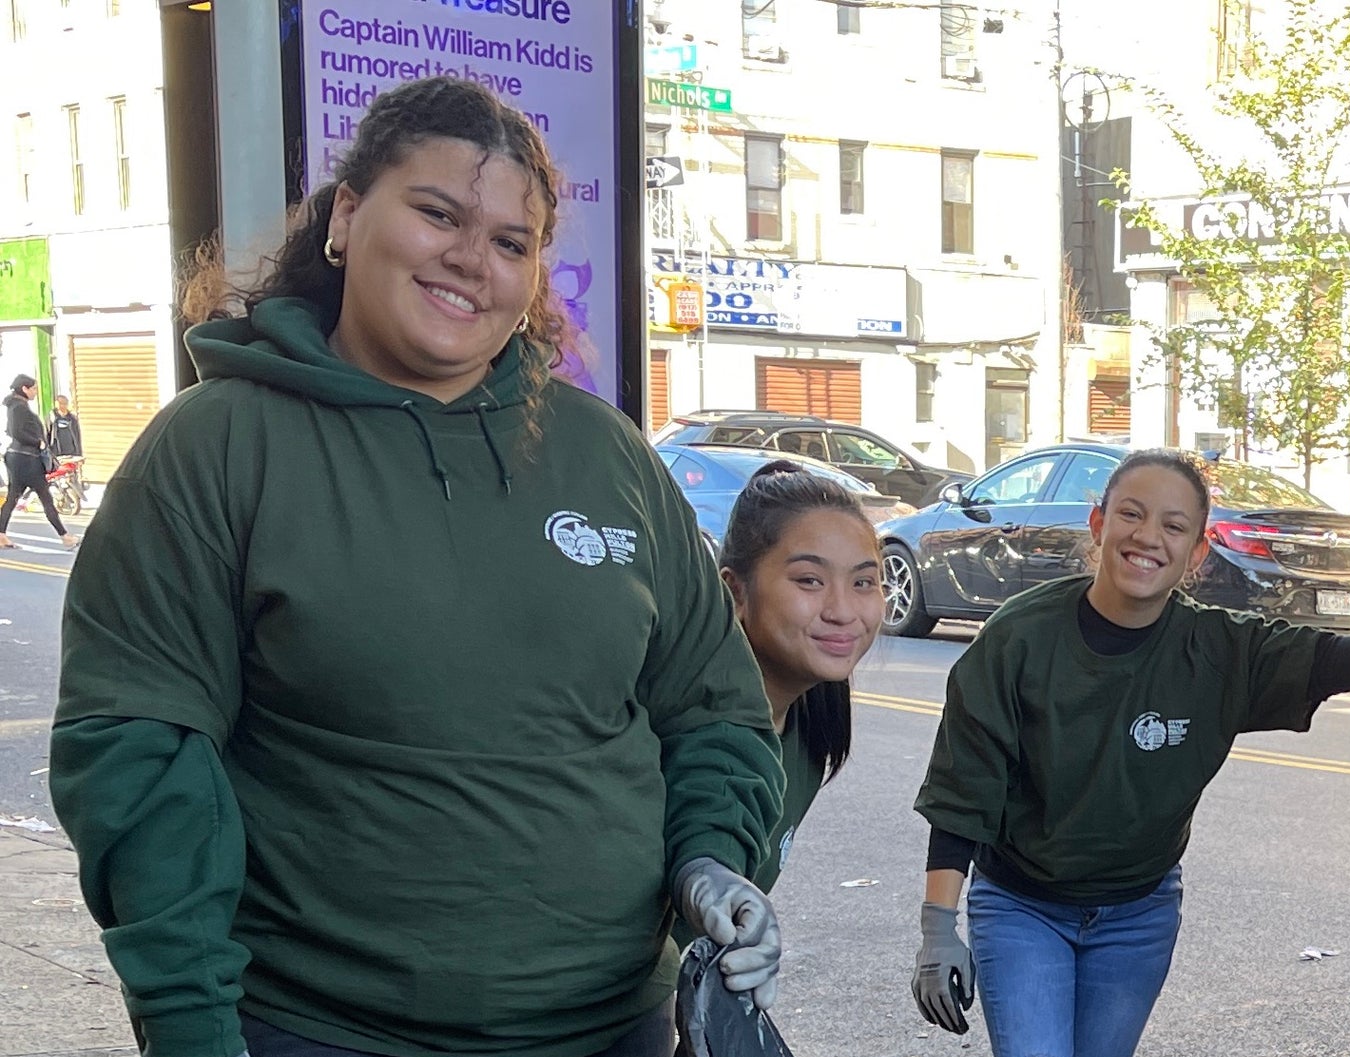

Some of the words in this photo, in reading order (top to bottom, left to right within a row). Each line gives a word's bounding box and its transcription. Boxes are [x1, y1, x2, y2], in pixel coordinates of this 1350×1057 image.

[441, 0, 571, 24] asure
[319, 9, 419, 48] Captain
[422, 24, 511, 62] William
[516, 38, 570, 70] Kidd
[574, 47, 594, 74] is
[320, 50, 430, 80] rumored
[434, 61, 460, 78] to
[464, 64, 522, 96] have
[321, 78, 377, 108] hidd
[651, 82, 710, 109] Nichols
[558, 178, 600, 203] ural
